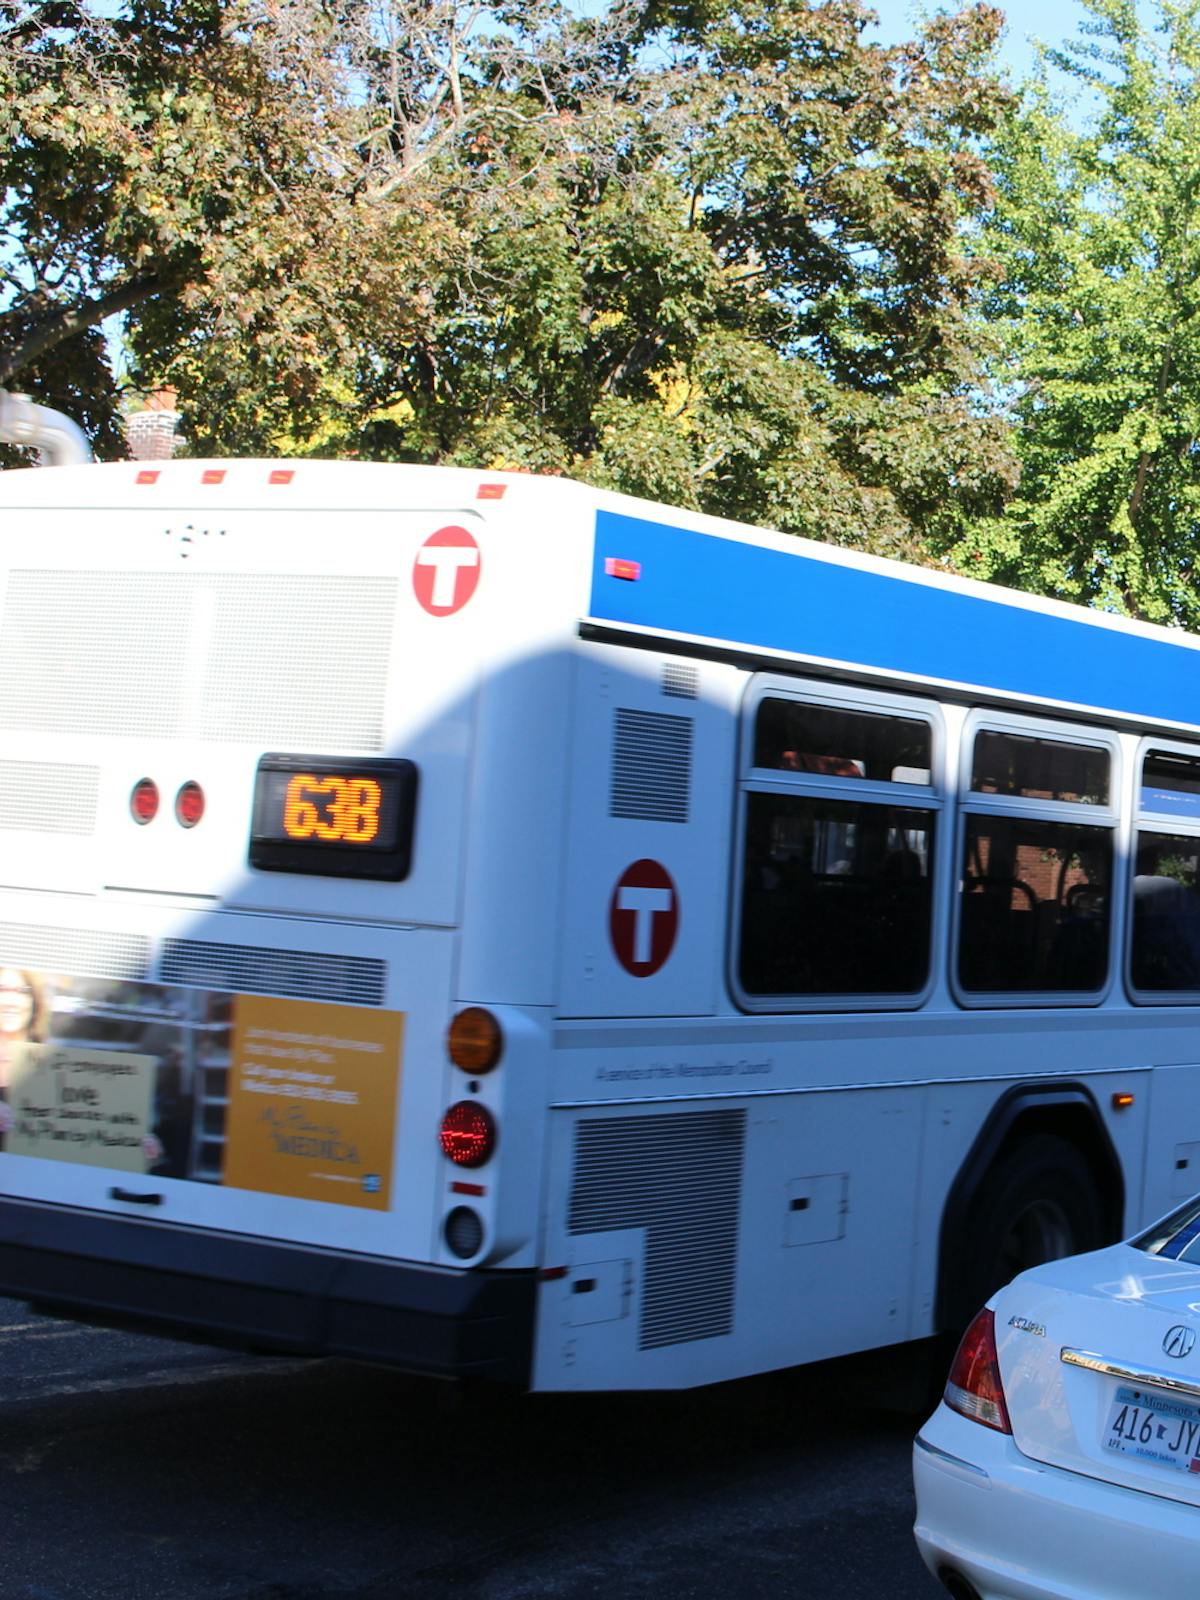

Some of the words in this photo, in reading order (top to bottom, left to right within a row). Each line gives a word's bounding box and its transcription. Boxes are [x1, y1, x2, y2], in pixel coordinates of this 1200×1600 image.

[282, 773, 384, 843] 63B
[1008, 1315, 1046, 1337] ACURA
[1143, 1395, 1194, 1416] Minnesota
[1112, 1405, 1155, 1444] 416
